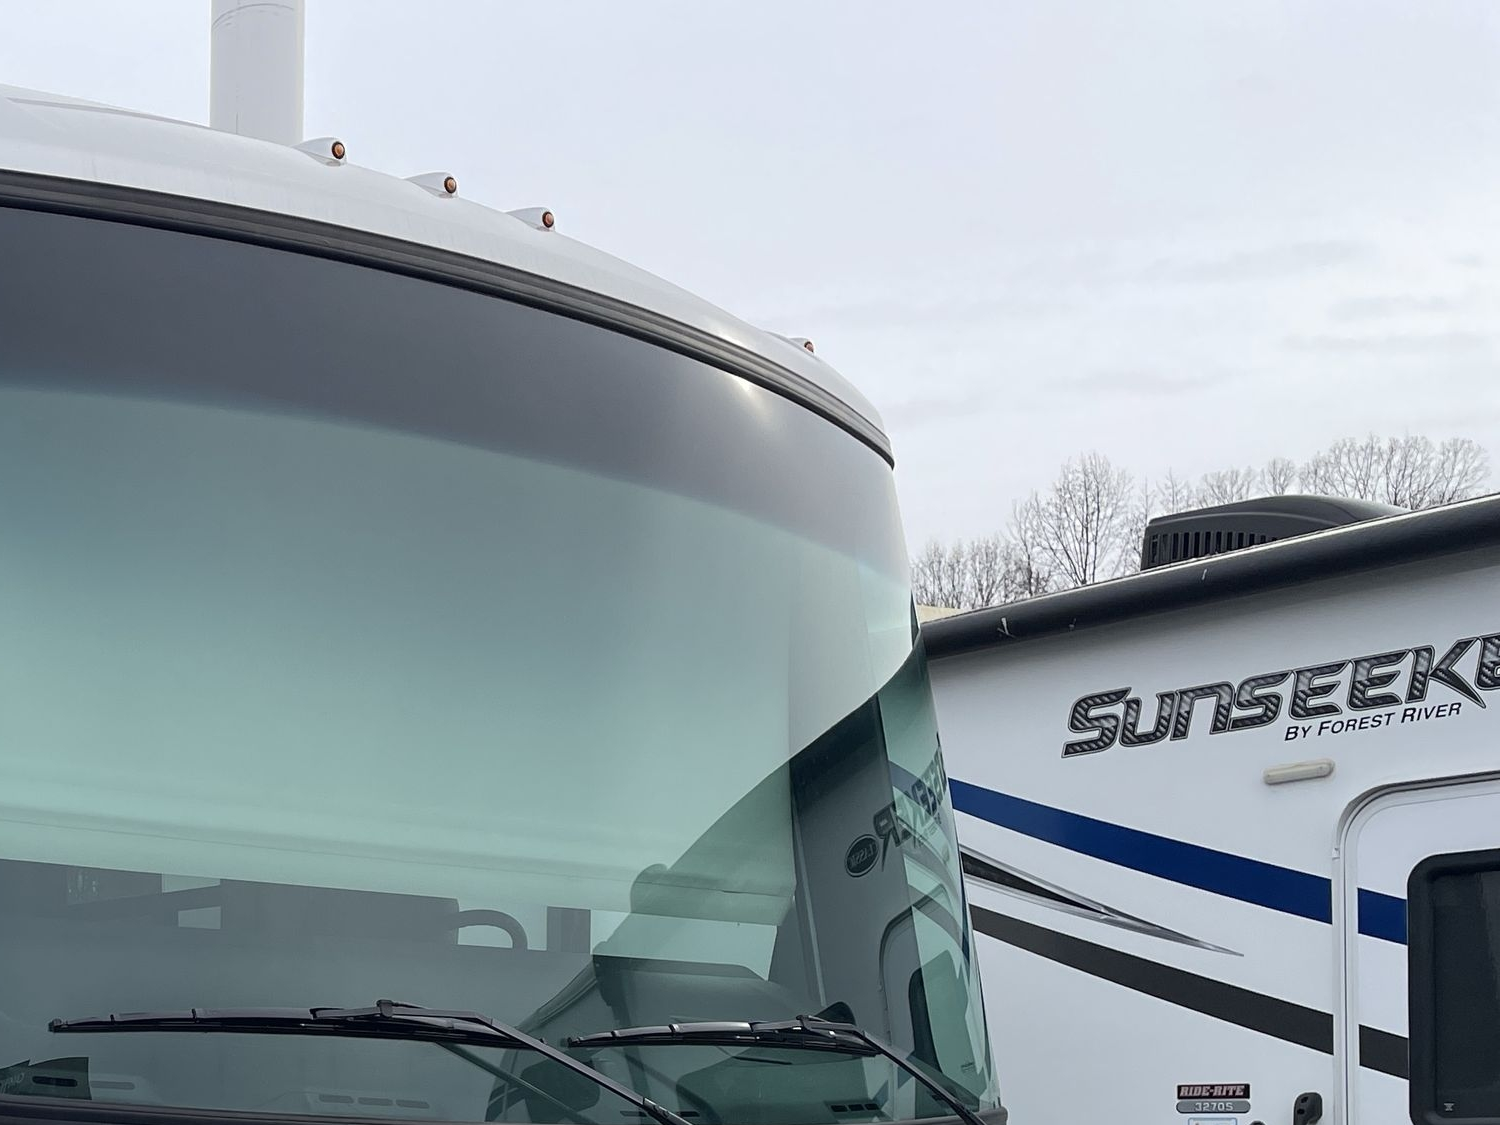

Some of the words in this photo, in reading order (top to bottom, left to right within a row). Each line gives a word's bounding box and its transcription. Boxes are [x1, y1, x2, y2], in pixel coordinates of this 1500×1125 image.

[1284, 725, 1312, 742] BY
[1317, 712, 1396, 736] FOREST
[1401, 702, 1462, 724] RIVER
[1179, 1085, 1245, 1097] RIDE-RITE
